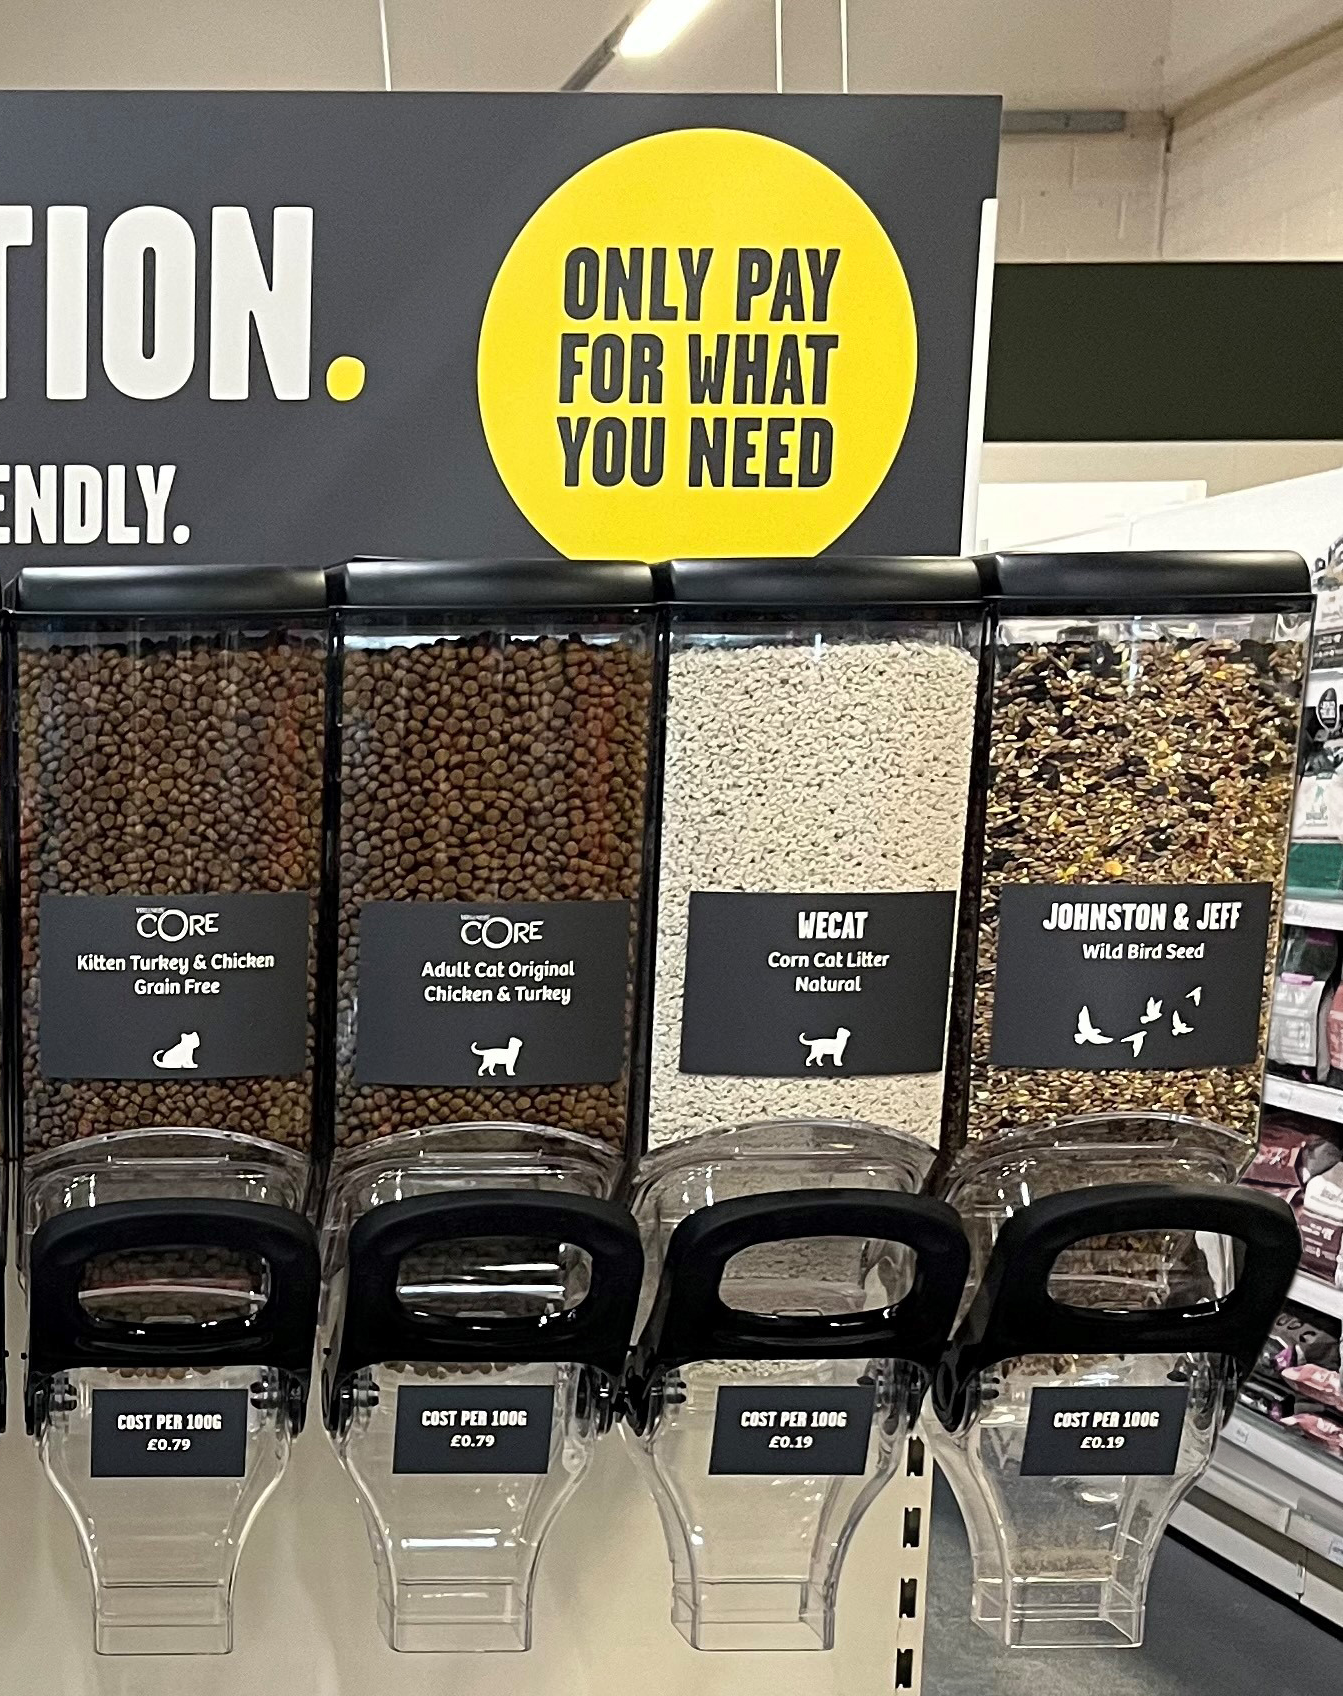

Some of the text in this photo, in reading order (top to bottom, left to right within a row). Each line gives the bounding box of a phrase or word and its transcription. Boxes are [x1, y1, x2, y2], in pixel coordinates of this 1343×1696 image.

[564, 247, 840, 321] ONLY PAY
[559, 333, 838, 404] FOR WHAT
[557, 417, 833, 487] YOU NEED
[1042, 901, 1242, 931] JOHNSTON & JEFF
[136, 908, 220, 943] CORE
[460, 916, 545, 950] CORE
[798, 911, 869, 940] WECAT
[767, 950, 890, 968] Corn Cat Litter
[1082, 942, 1205, 960] Wild Bird Seed
[77, 952, 275, 976] Kitten Turkey & Chicken
[421, 959, 575, 982] Adult Cat Original
[134, 977, 221, 995] Grain Free
[795, 975, 862, 992] Natural
[424, 984, 571, 1006] Chicken & Turkey
[117, 1413, 222, 1430] COST PER 100G
[740, 1411, 848, 1428] COST PER 100G
[1053, 1411, 1160, 1428] COST PER 100G
[146, 1438, 191, 1451] £0.79
[450, 1434, 495, 1448] £0.79
[768, 1435, 813, 1449] £0.19
[1080, 1436, 1125, 1449] £0.19
